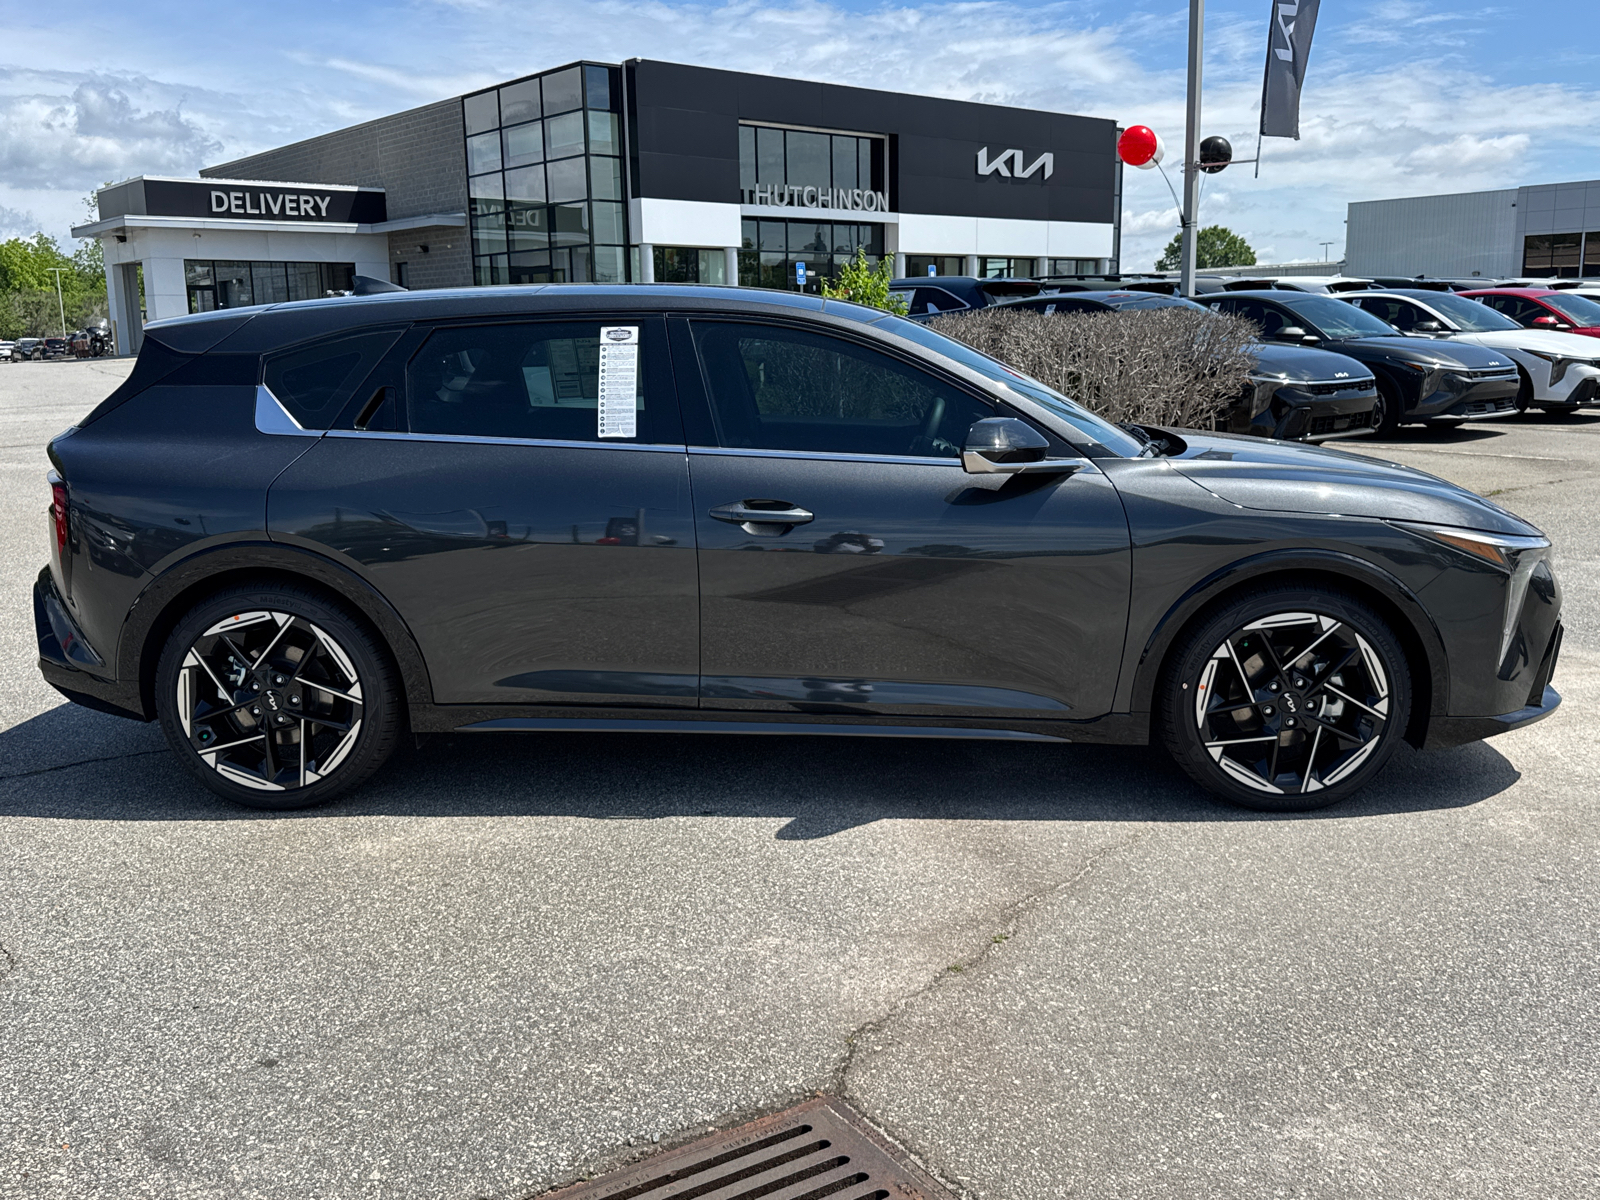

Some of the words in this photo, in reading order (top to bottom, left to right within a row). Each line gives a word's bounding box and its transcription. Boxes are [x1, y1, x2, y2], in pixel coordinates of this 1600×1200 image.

[1274, 0, 1300, 62] KI
[977, 146, 1054, 181] KIA
[210, 190, 332, 218] DELIVERY
[754, 183, 889, 212] HUTCHINSON
[1353, 613, 1376, 635] 235/40
[165, 719, 199, 772] KUMHO
